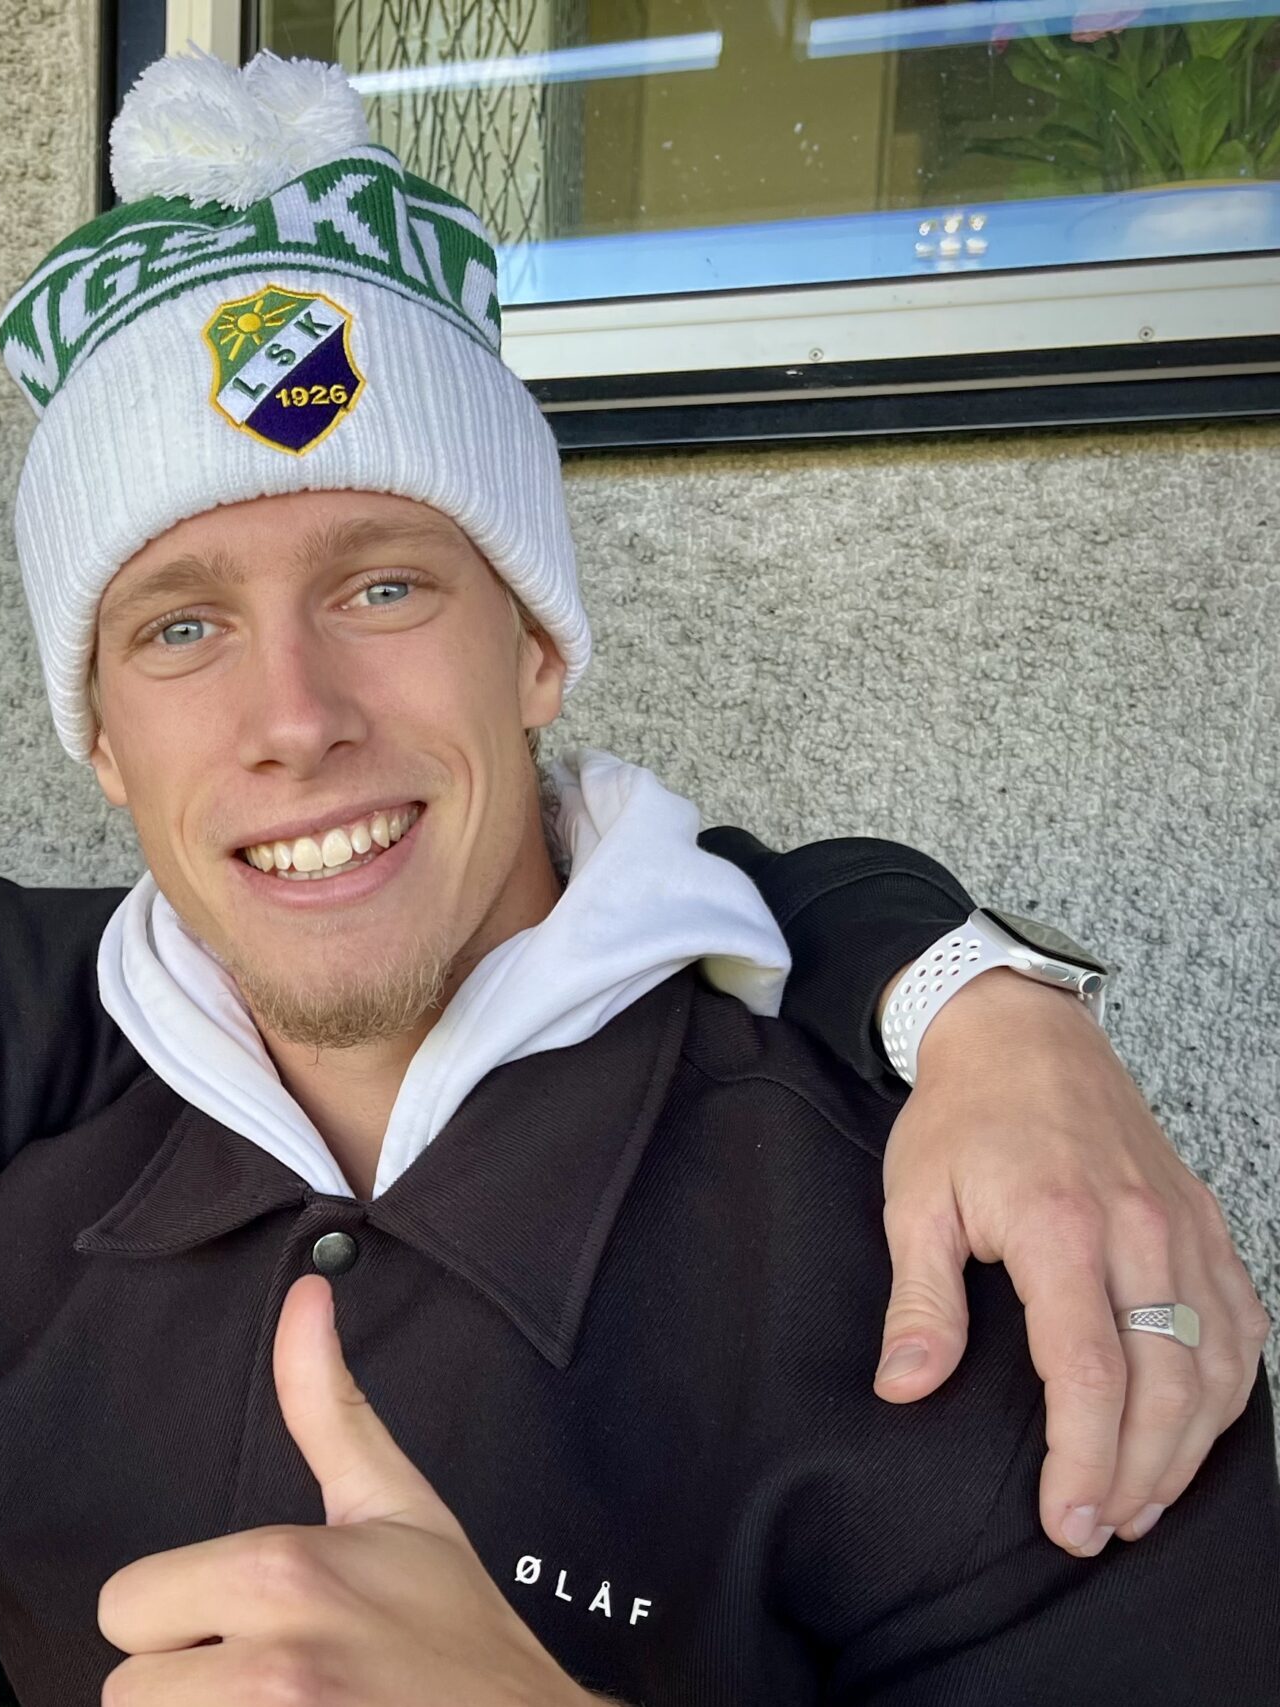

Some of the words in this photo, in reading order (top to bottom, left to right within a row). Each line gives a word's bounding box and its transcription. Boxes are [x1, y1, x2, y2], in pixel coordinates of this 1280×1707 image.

[232, 310, 333, 401] LSK
[275, 384, 349, 408] 1926
[514, 1555, 652, 1625] ØLÅF
